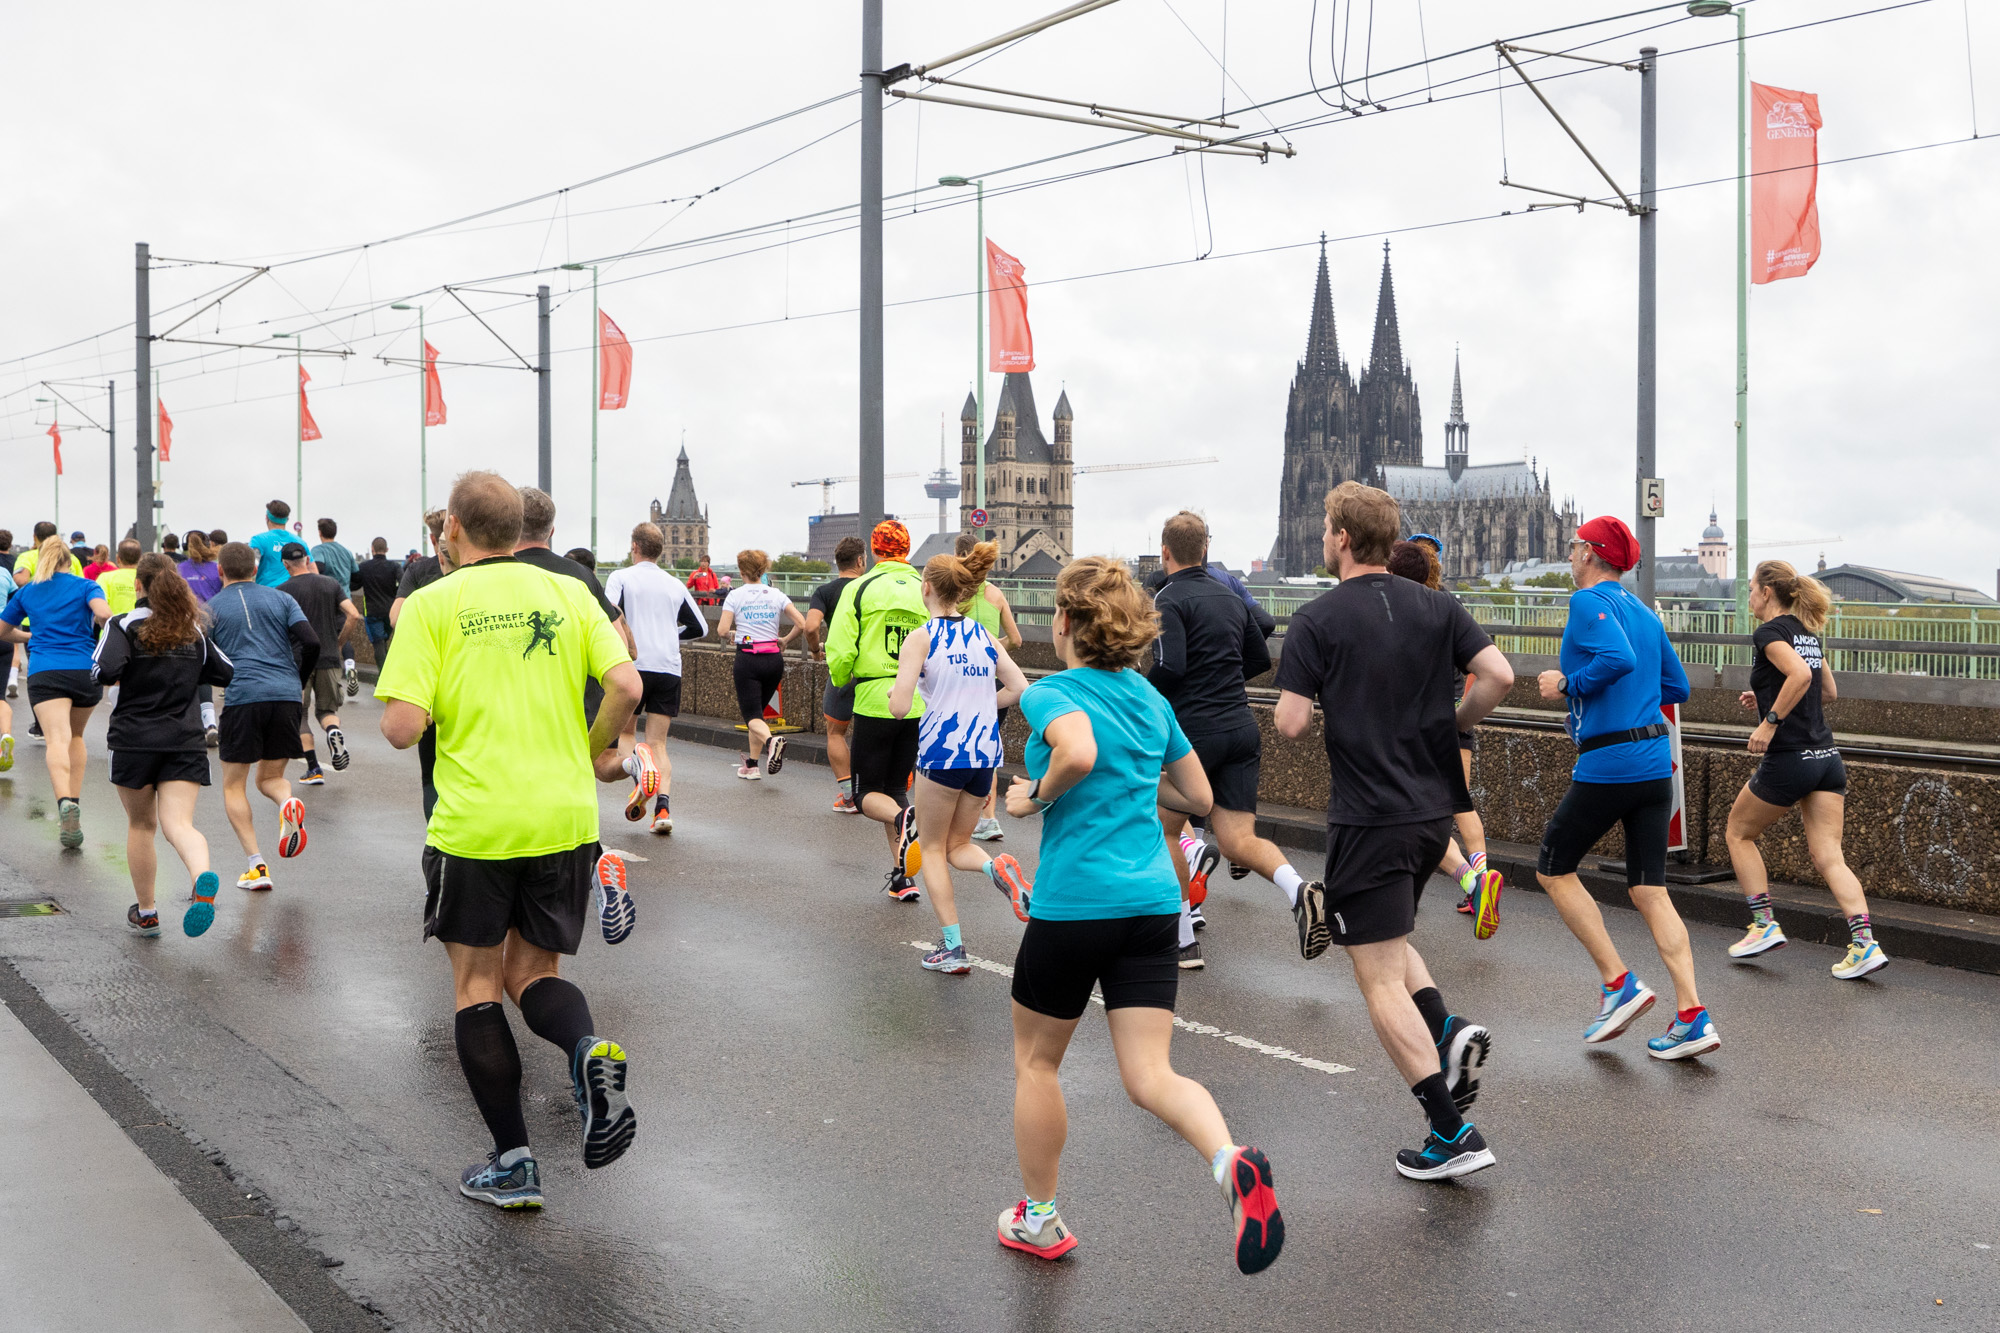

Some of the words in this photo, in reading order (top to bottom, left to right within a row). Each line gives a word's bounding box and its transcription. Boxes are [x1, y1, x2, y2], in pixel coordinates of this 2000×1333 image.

[1647, 483, 1658, 512] 5
[460, 612, 523, 629] LAUFTREFF
[884, 615, 919, 625] Lauf-Club
[462, 621, 525, 636] WESTERWALD
[947, 653, 968, 665] TUS
[962, 663, 989, 677] KÖLN
